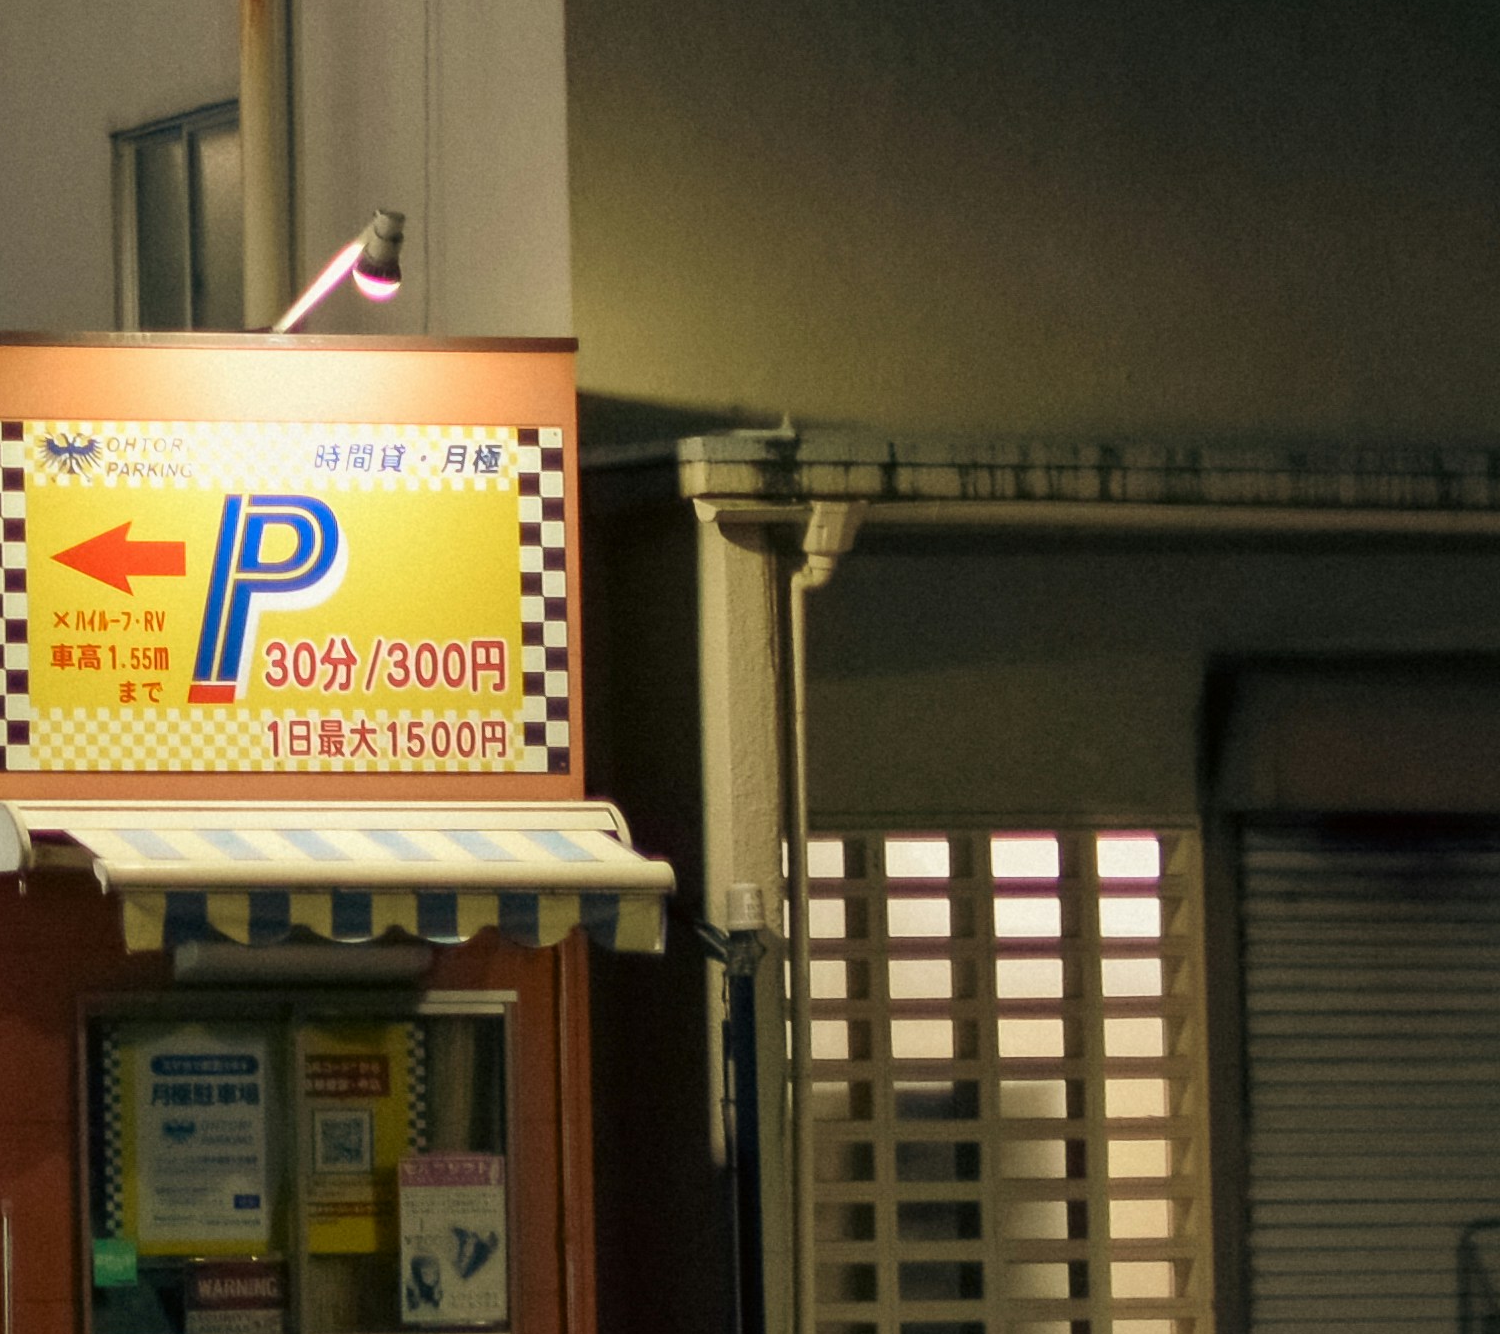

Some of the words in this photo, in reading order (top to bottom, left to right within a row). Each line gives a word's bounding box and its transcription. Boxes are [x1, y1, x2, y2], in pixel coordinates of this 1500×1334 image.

[106, 461, 193, 478] PARKING
[314, 443, 503, 474] 時間貸・月極
[187, 493, 340, 705] P
[265, 637, 506, 692] 30分/300円
[119, 680, 164, 704] まで
[267, 718, 507, 759] 1日最大1500円
[198, 1277, 278, 1298] WARNING
